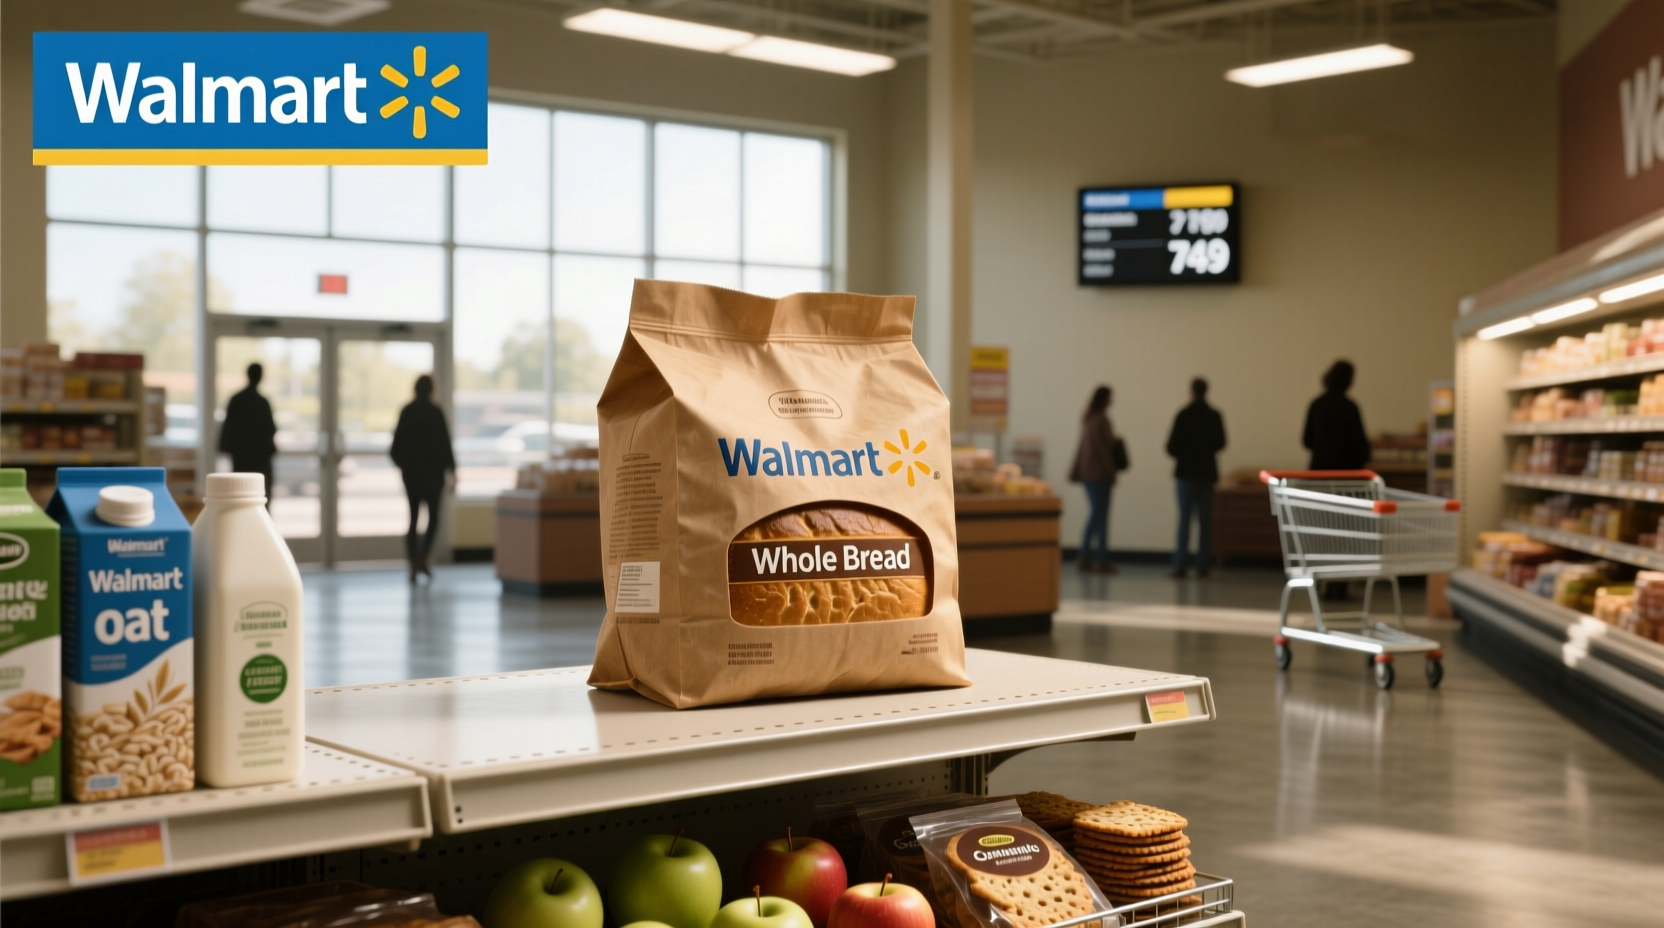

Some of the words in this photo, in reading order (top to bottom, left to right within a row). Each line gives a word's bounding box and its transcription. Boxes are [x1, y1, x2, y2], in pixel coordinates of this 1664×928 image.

[1167, 237, 1230, 275] 749
[717, 437, 884, 477] Walmart
[751, 544, 837, 575] Whole
[843, 543, 910, 571] Bread
[88, 566, 183, 593] Walmart
[94, 599, 170, 645] oat
